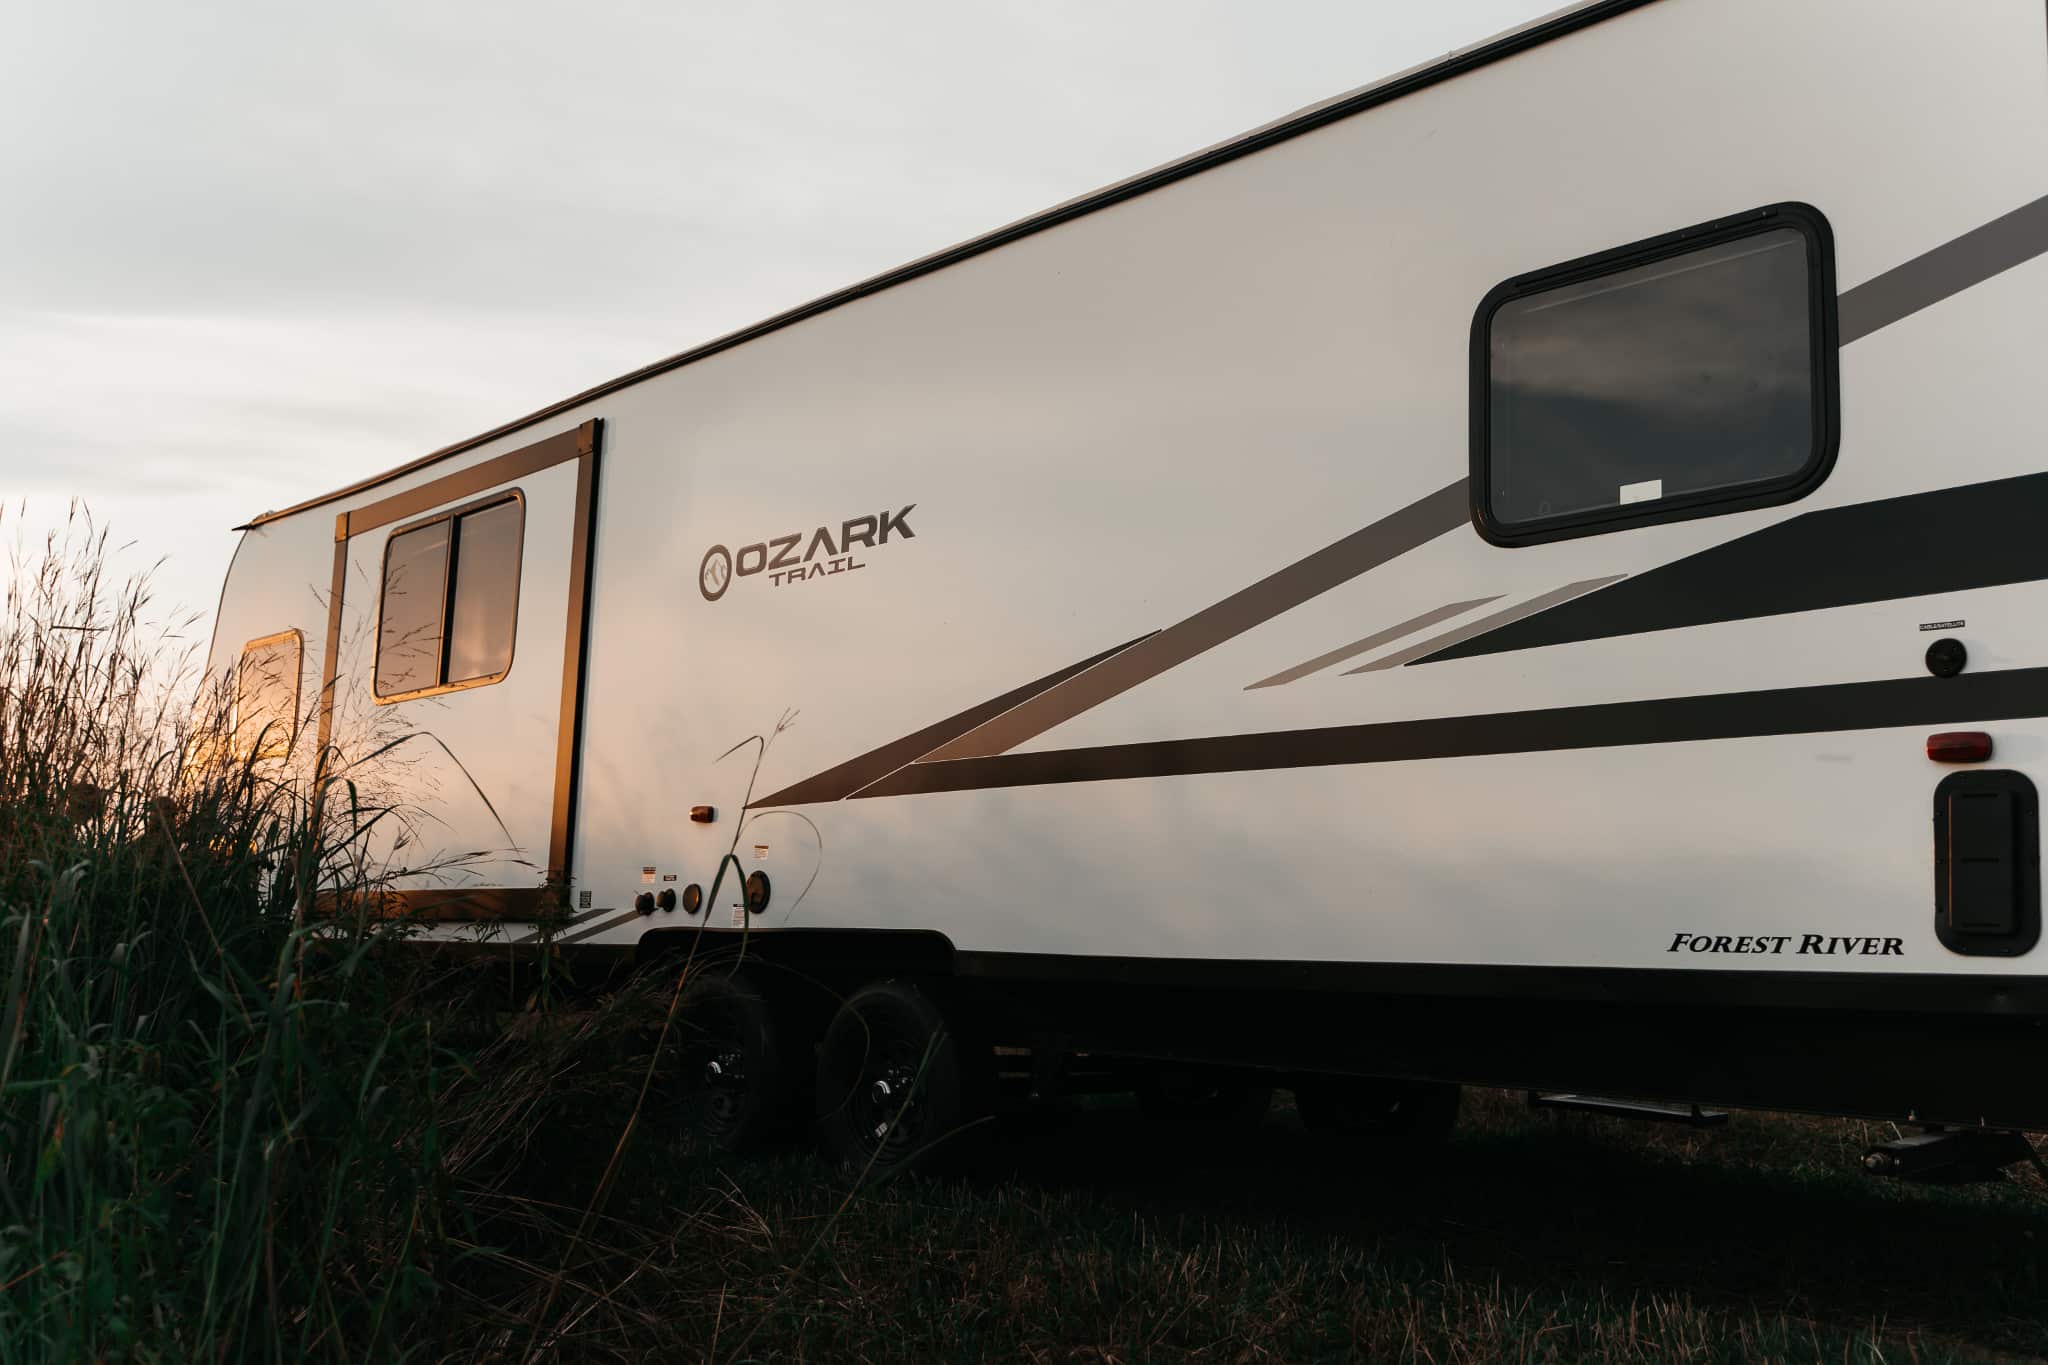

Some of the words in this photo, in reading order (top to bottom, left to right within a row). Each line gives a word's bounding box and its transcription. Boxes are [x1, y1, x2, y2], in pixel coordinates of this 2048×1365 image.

[735, 503, 917, 577] OZARK
[768, 556, 866, 587] TRAIL
[1667, 933, 1791, 954] FOREST
[1796, 934, 1904, 955] RIVER
